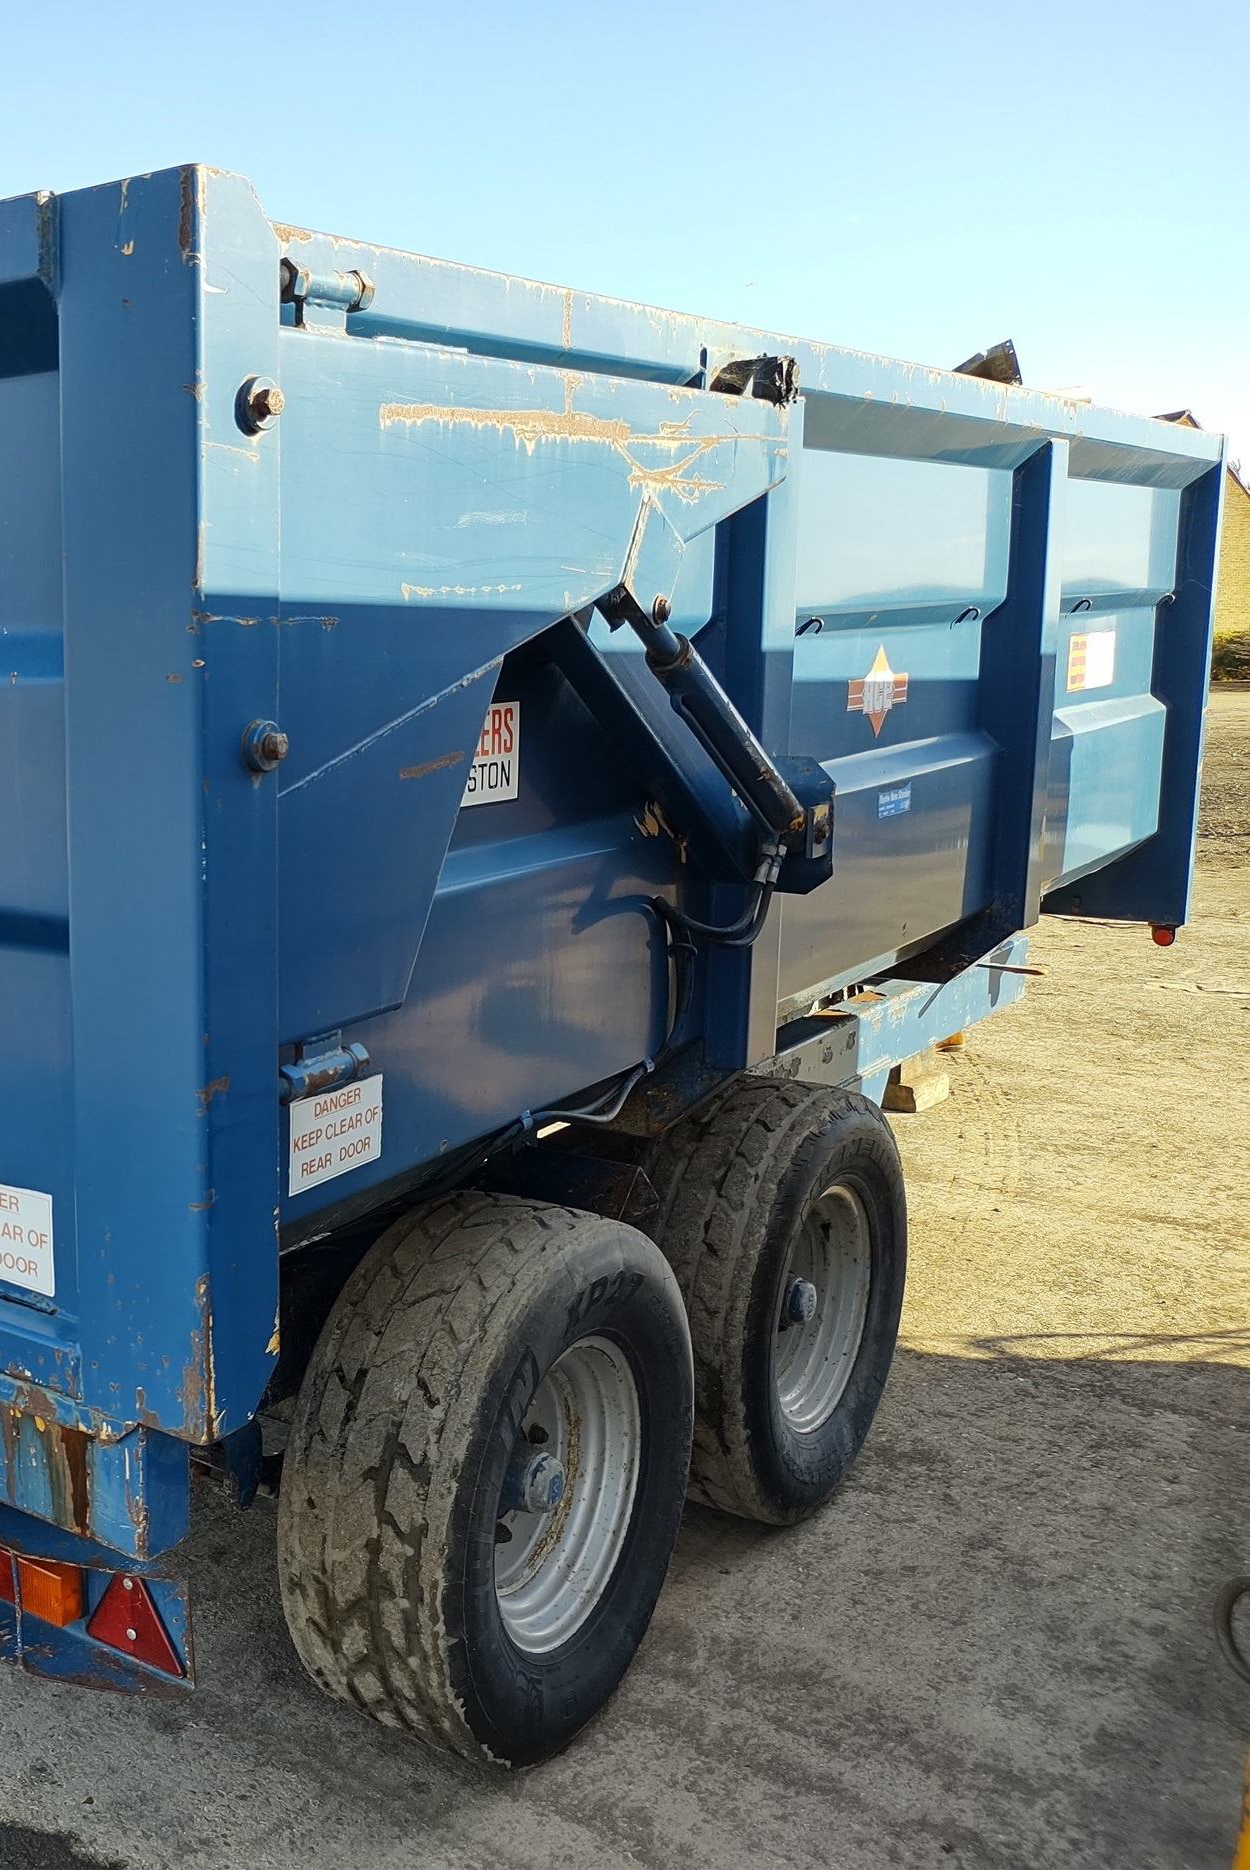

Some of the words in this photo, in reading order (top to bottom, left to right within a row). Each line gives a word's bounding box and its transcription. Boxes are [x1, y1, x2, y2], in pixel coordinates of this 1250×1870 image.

[475, 707, 514, 757] ERS
[314, 1087, 361, 1117] DANGER
[293, 1128, 322, 1153] KEEP
[325, 1112, 362, 1140] CLEAR
[364, 1106, 379, 1124] OF
[301, 1152, 332, 1178] REAR
[339, 1136, 371, 1162] DOOR
[27, 1230, 48, 1249] OF
